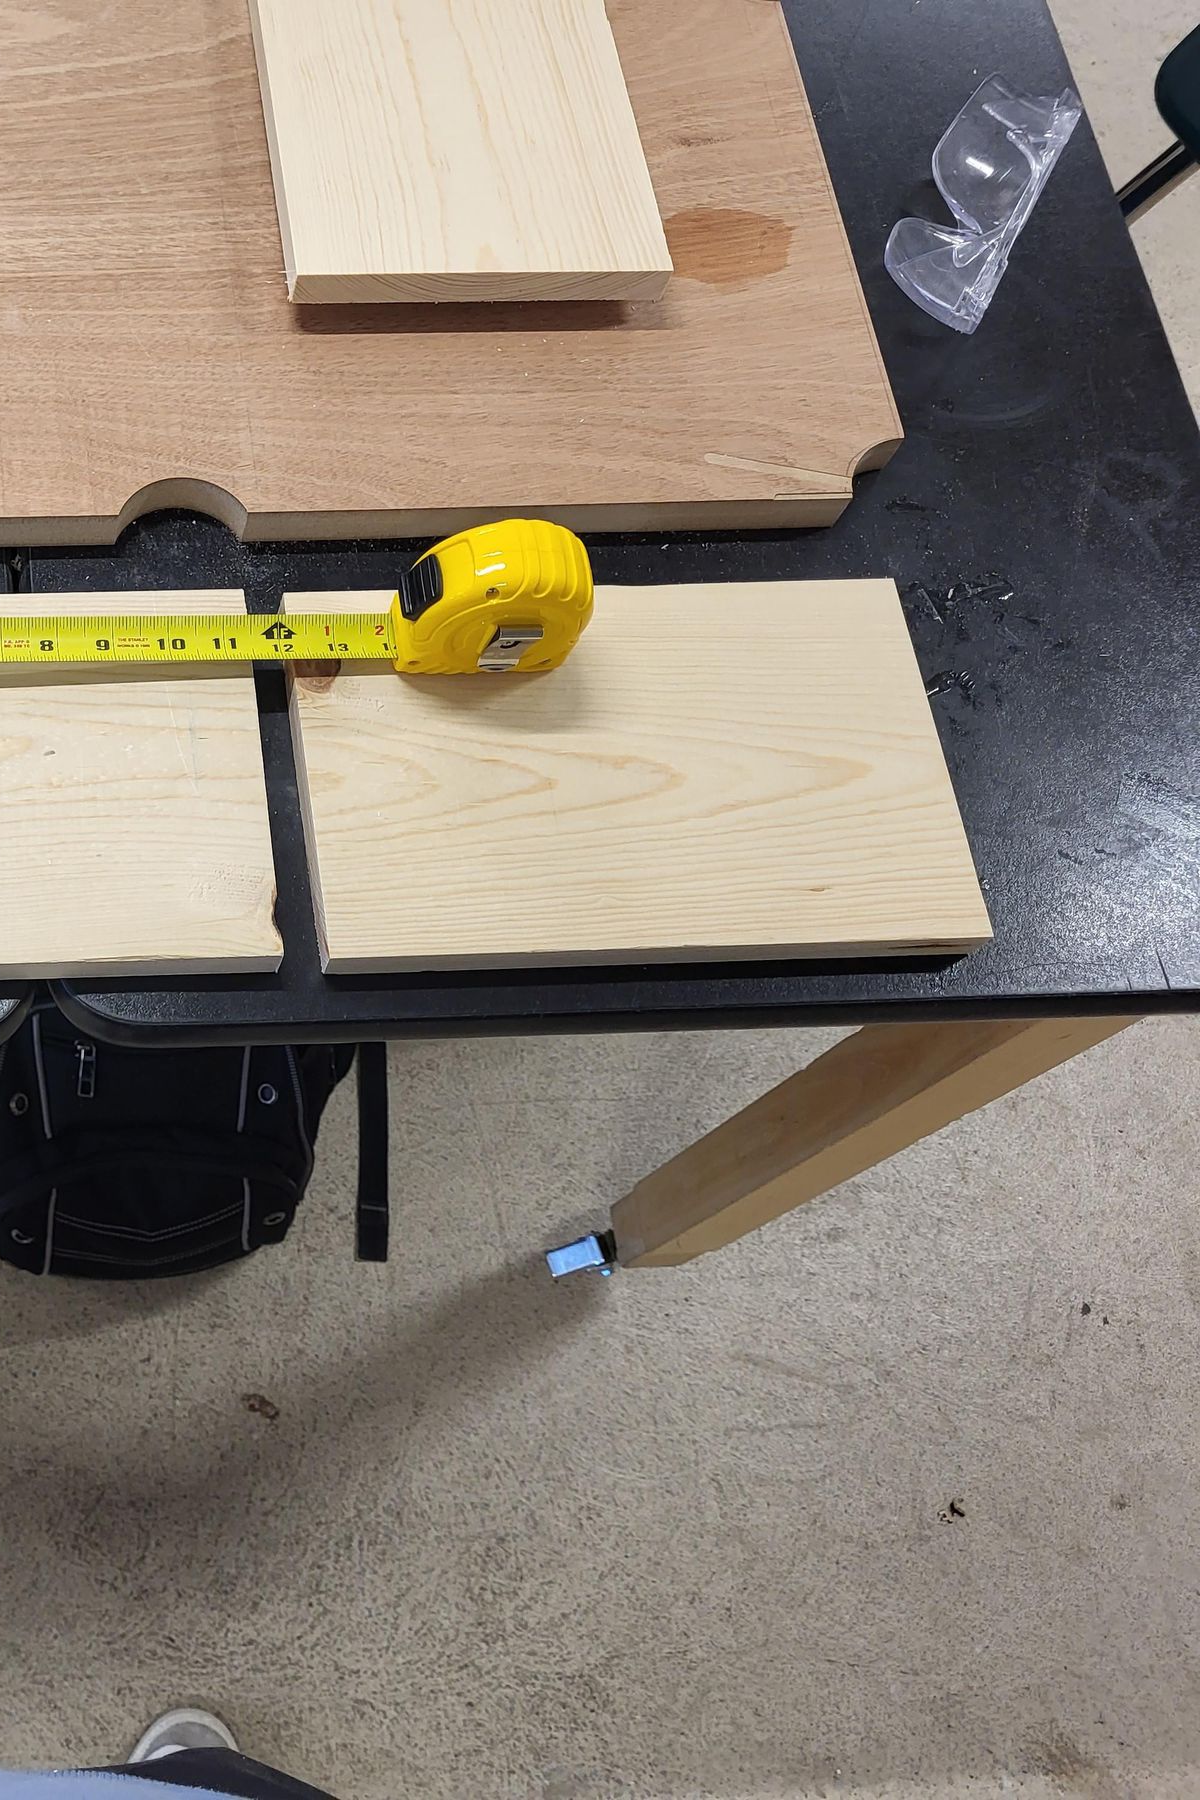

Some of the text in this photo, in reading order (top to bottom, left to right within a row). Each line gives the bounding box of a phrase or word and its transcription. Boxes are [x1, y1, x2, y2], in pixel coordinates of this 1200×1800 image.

[324, 625, 385, 636] 1 2
[39, 640, 54, 651] 8
[95, 639, 110, 651] 9
[157, 638, 186, 650] 10
[212, 637, 237, 649] 11
[272, 644, 294, 652] 12
[327, 643, 349, 652] 13
